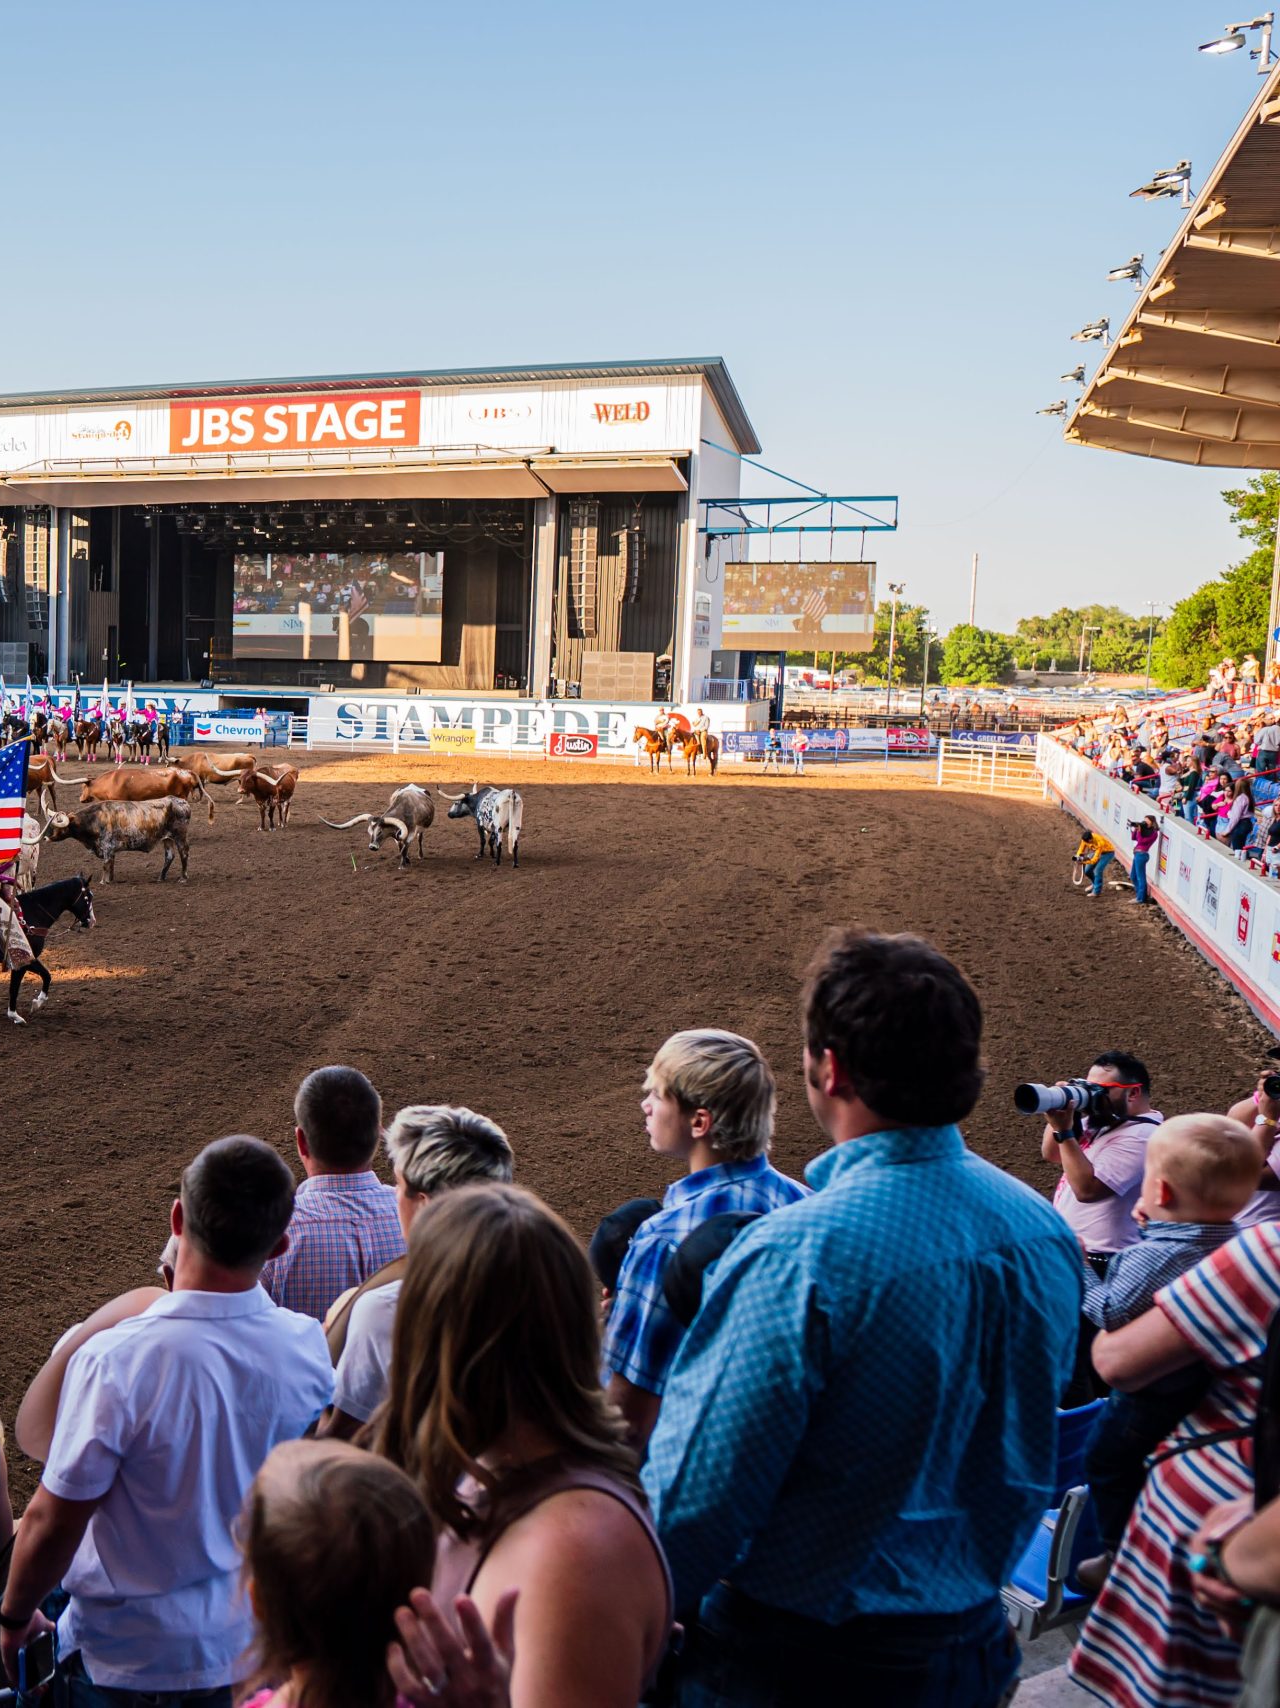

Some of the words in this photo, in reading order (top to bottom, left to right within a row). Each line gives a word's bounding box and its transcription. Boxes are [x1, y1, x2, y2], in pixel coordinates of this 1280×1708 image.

[594, 401, 650, 423] WELD
[182, 406, 255, 446] JBS
[263, 400, 406, 443] STAGE
[215, 724, 262, 736] Chevron
[433, 733, 475, 746] Wrangler
[554, 734, 592, 755] Justin
[977, 735, 1006, 743] GREELEY
